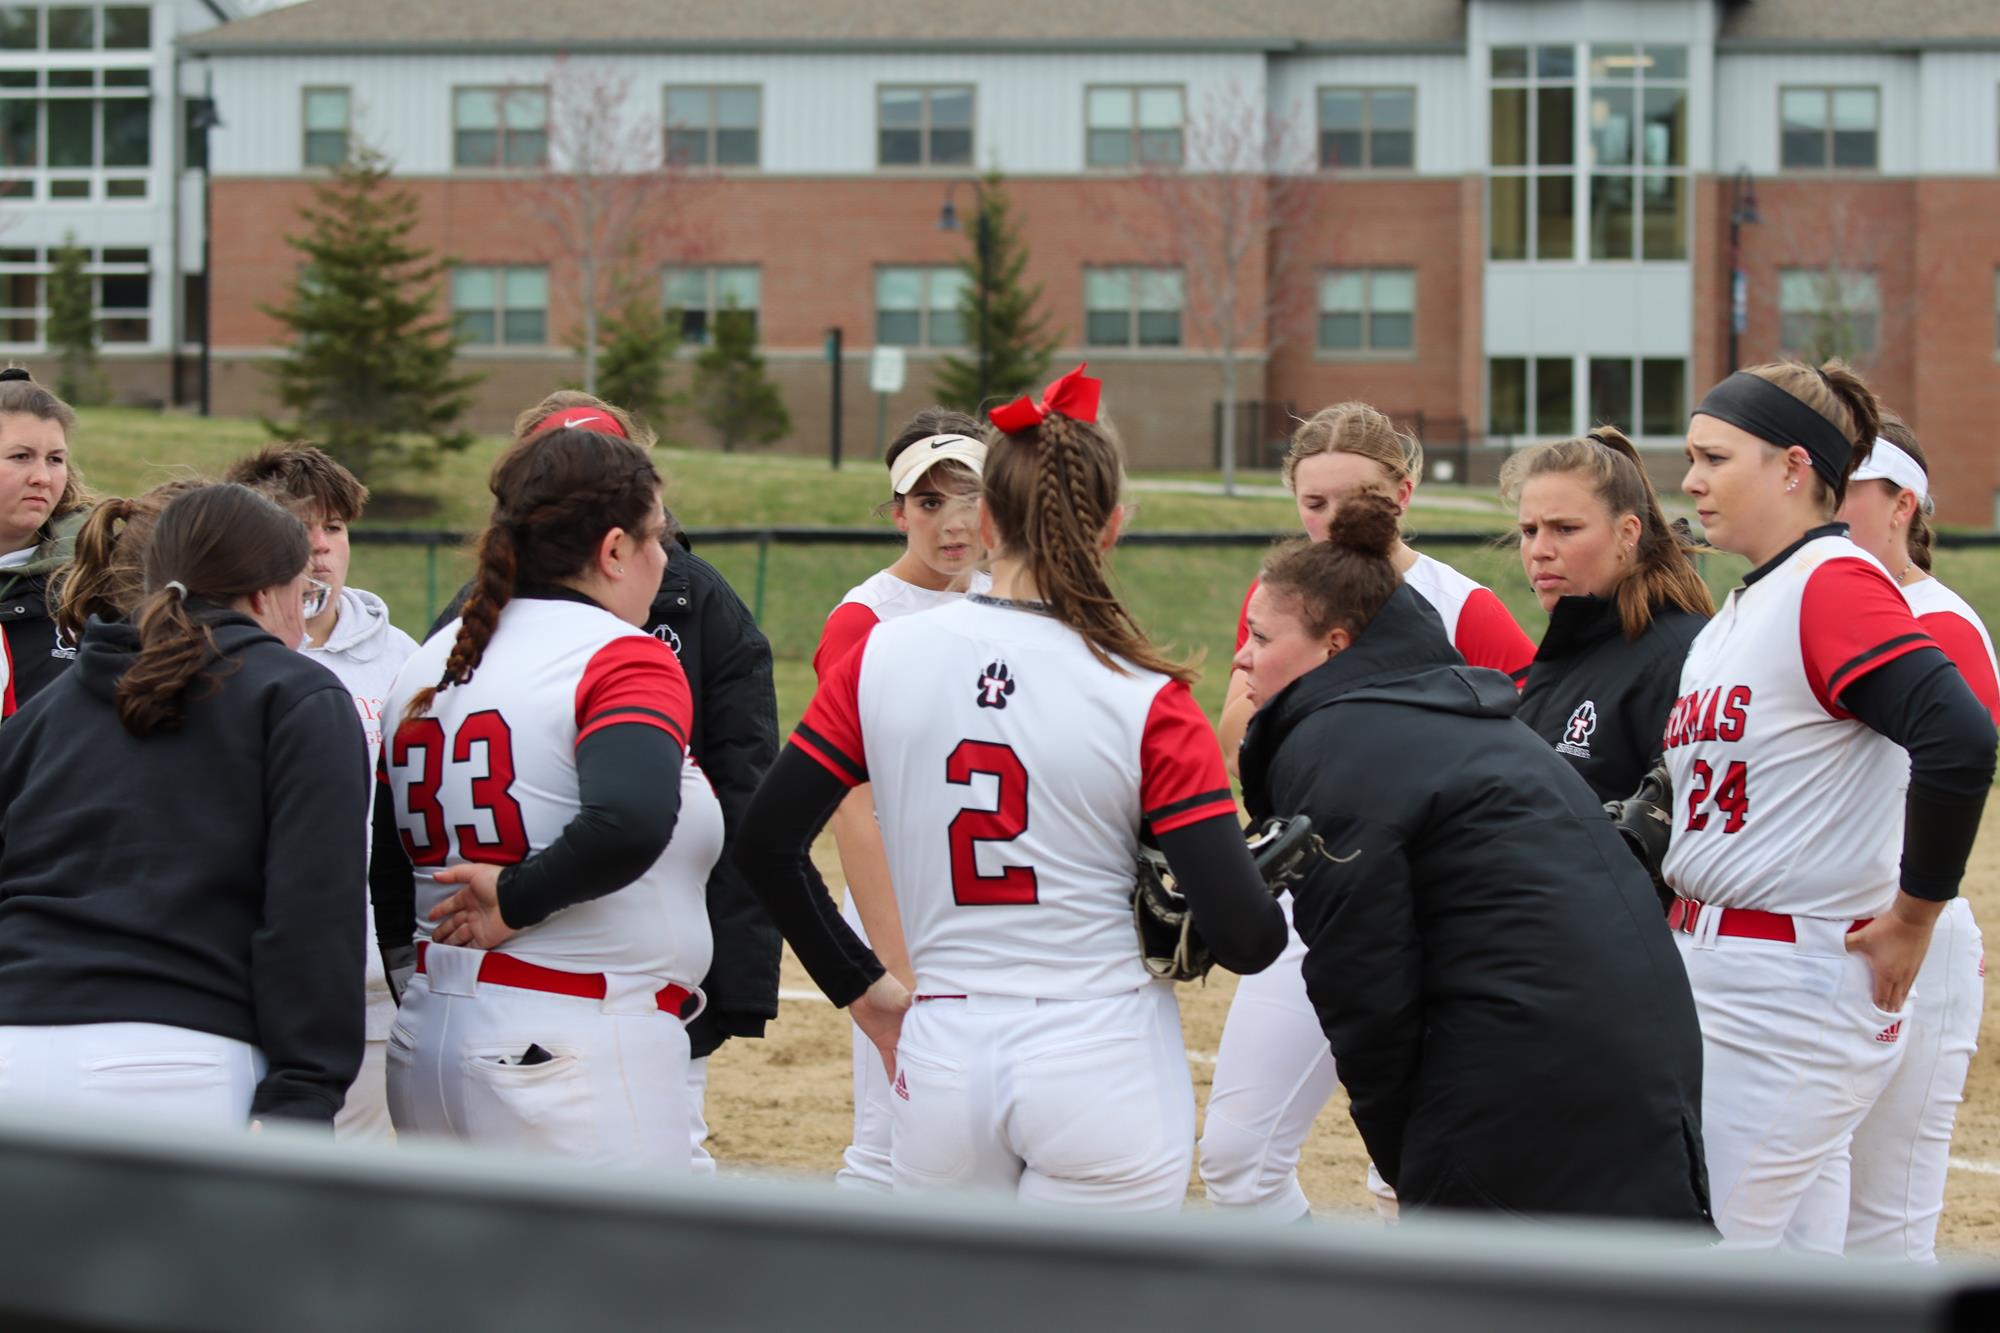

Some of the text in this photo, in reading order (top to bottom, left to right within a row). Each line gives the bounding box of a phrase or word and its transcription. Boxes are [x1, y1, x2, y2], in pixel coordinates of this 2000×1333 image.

[983, 676, 1006, 704] T
[1663, 685, 1752, 751] OMAS
[1571, 717, 1589, 741] T
[393, 709, 531, 867] 33
[946, 738, 1040, 906] 2
[1685, 758, 1749, 834] 24
